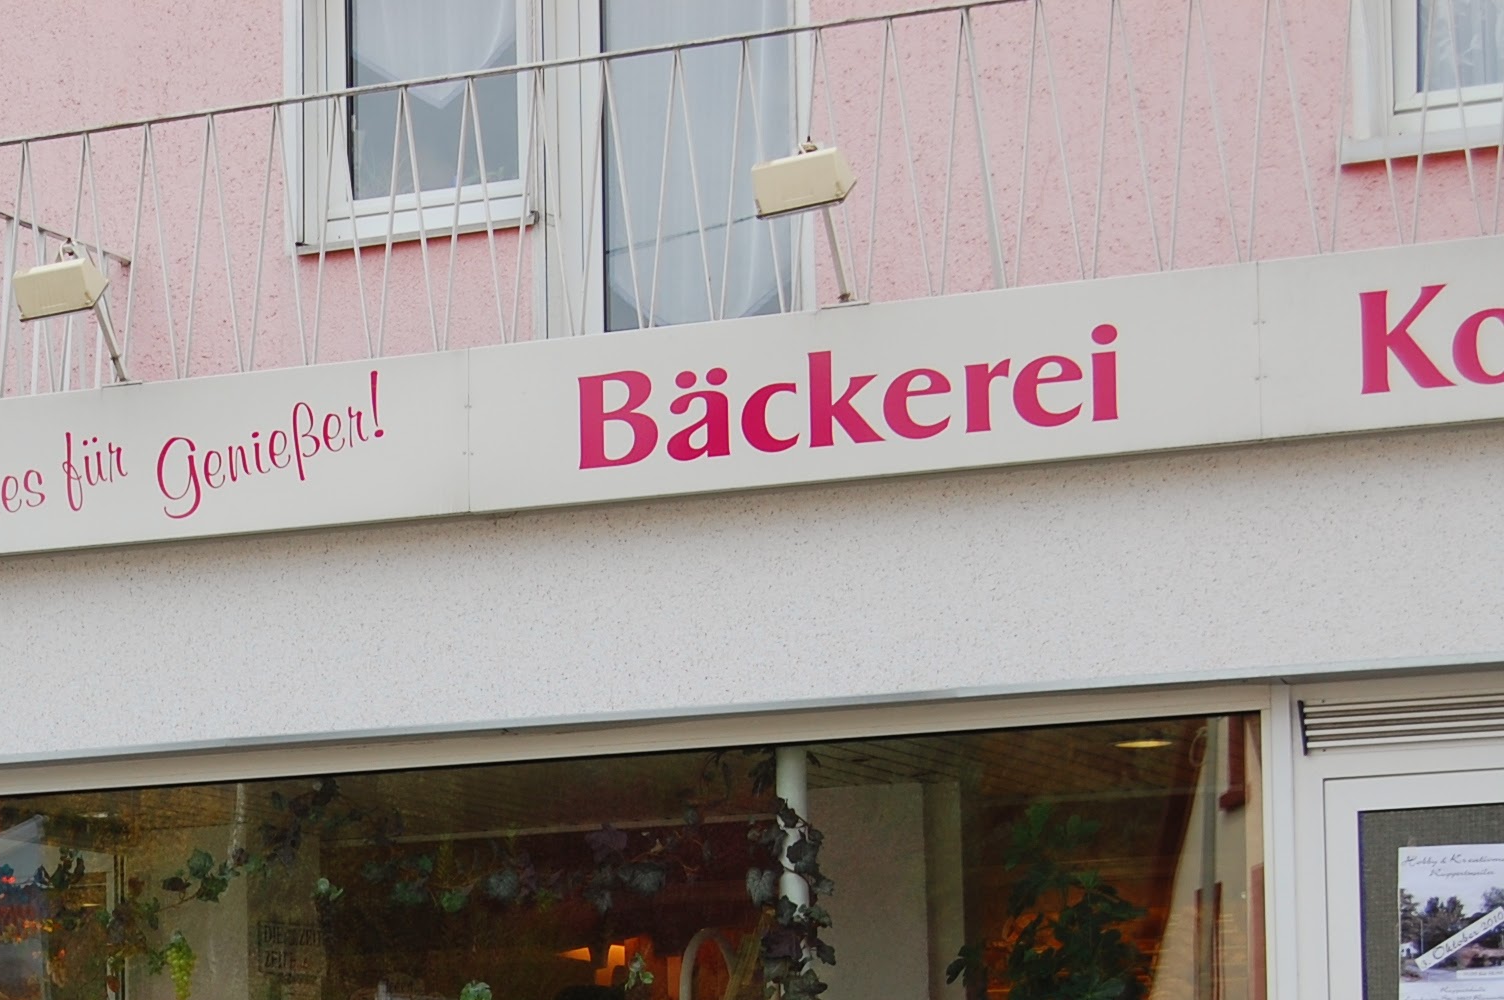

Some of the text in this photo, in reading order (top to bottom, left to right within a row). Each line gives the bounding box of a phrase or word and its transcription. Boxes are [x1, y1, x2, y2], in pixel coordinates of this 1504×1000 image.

[62, 431, 129, 512] für
[156, 370, 385, 519] Genießer!
[577, 323, 1120, 470] Bäckerei
